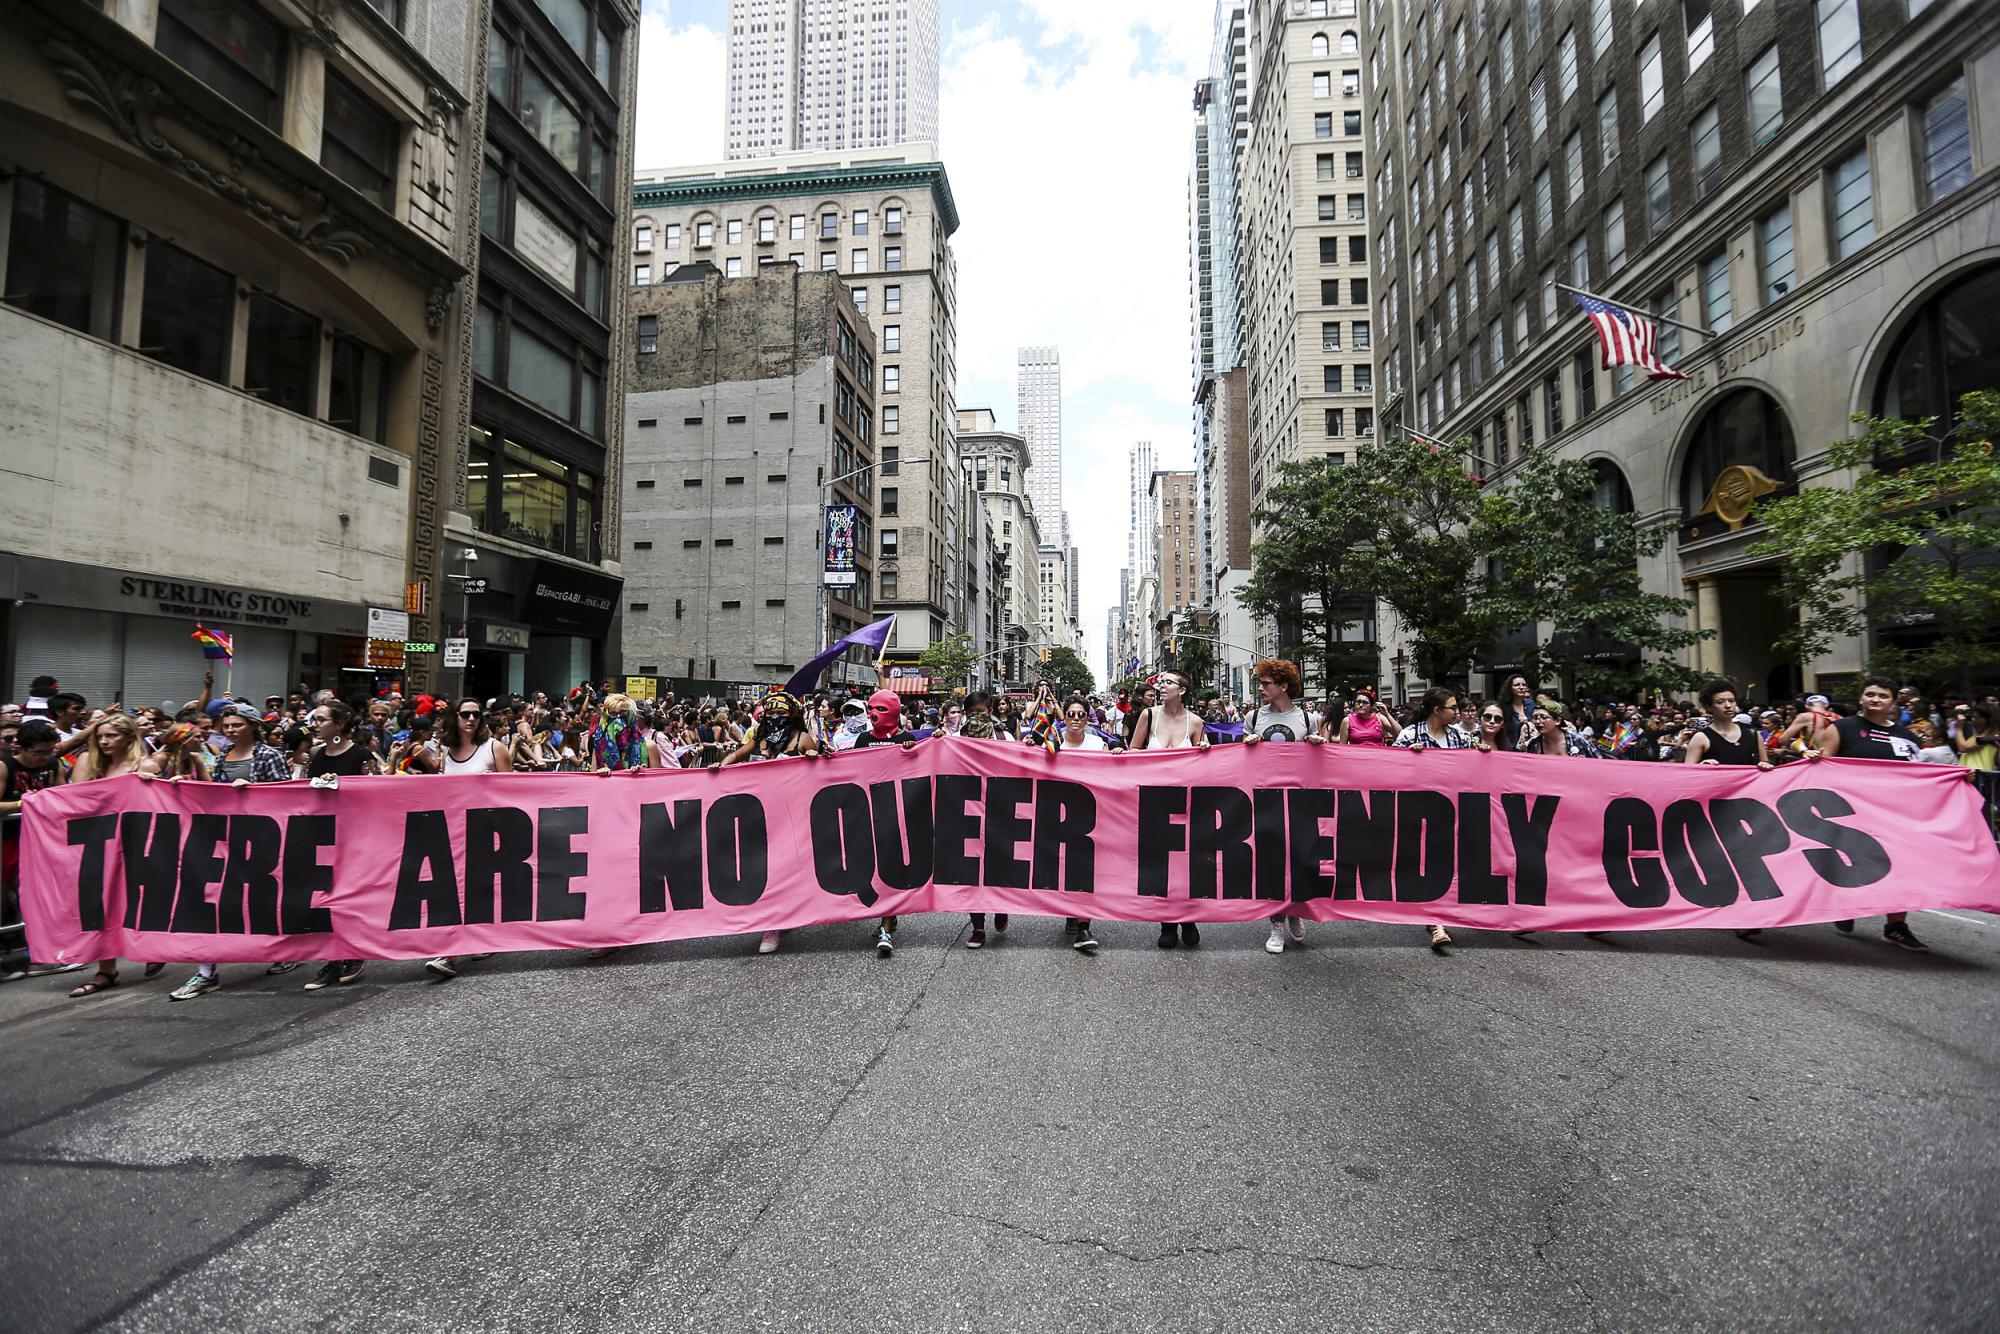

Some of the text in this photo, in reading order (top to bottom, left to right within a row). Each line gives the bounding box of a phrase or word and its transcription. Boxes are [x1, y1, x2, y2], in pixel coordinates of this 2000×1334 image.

[1650, 315, 1806, 415] TEXTILE BUILDING
[828, 511, 844, 519] NYC
[830, 516, 851, 525] PRIDE
[120, 576, 312, 617] STERLING STONE
[67, 774, 1892, 935] THERE ARE NO QUEER FRIENDLY COPS
